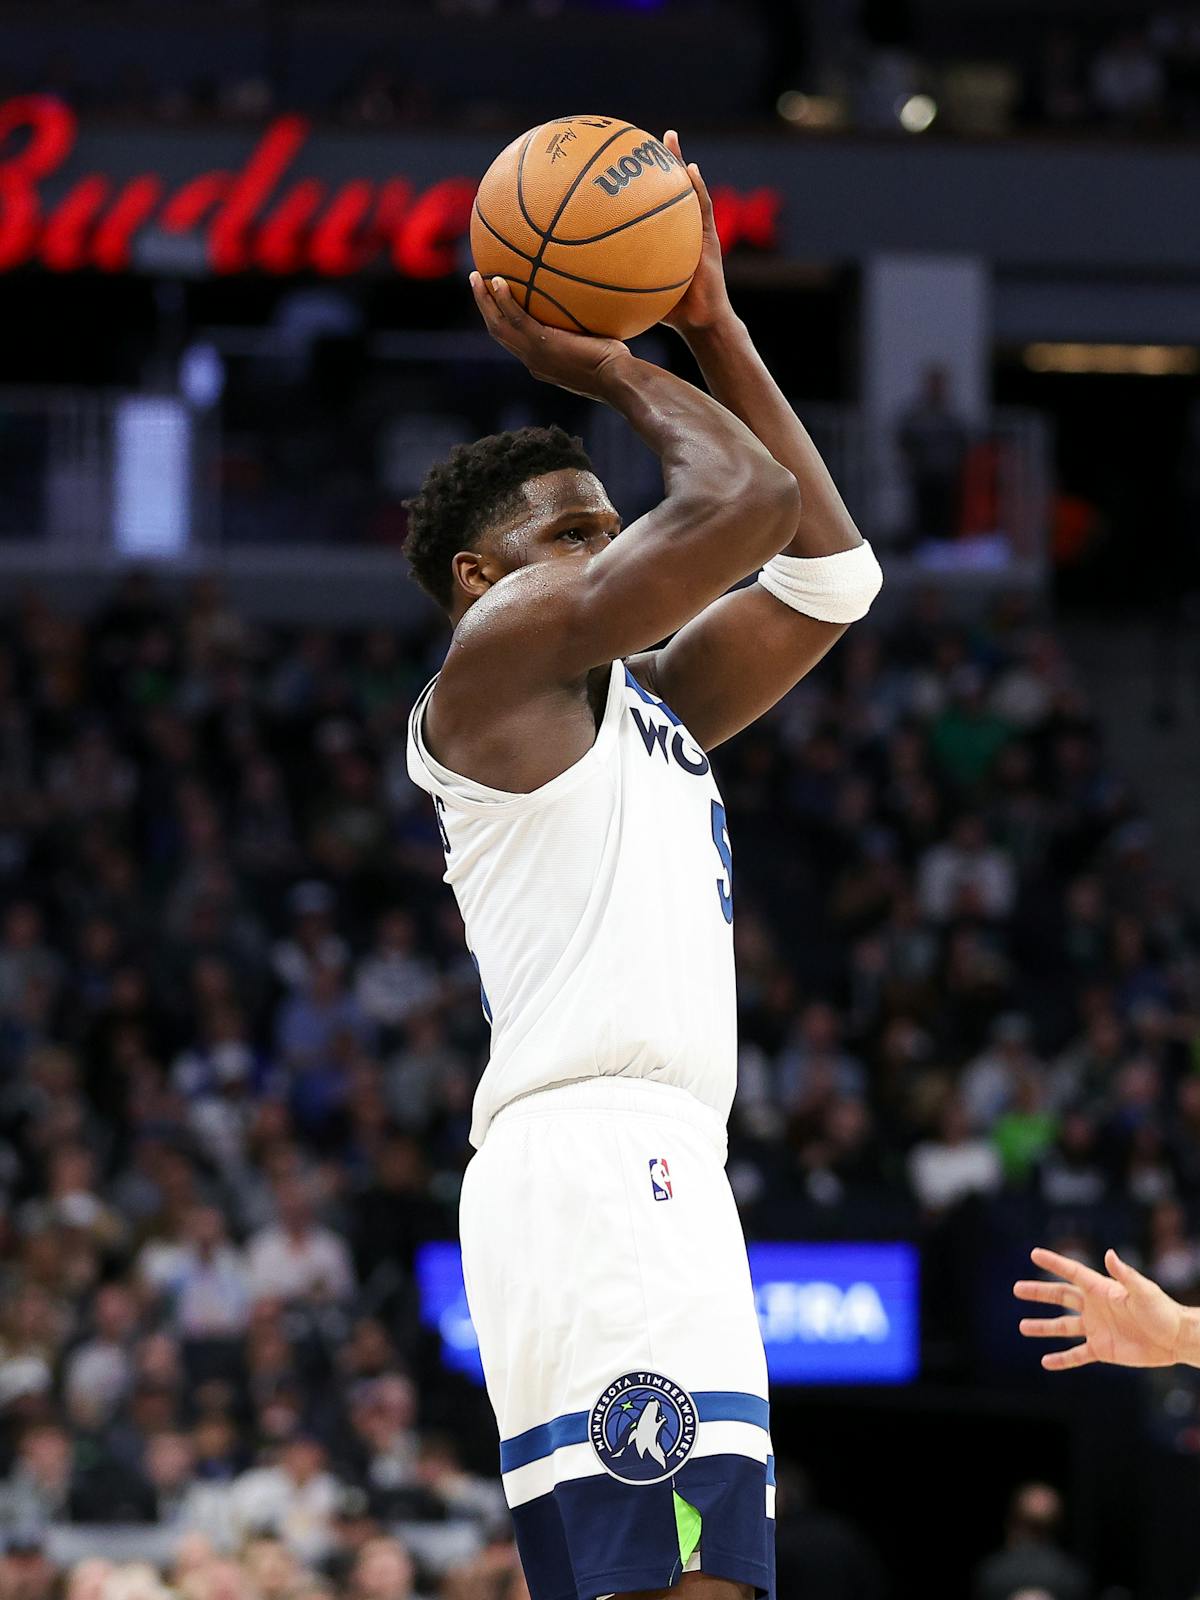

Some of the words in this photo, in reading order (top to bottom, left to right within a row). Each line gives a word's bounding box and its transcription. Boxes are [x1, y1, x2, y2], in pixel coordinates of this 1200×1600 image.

[0, 95, 780, 278] Budwer
[754, 1281, 891, 1342] TRA
[592, 1377, 632, 1451] MINNESOTA
[637, 1373, 694, 1458] TIMBERWOLVES
